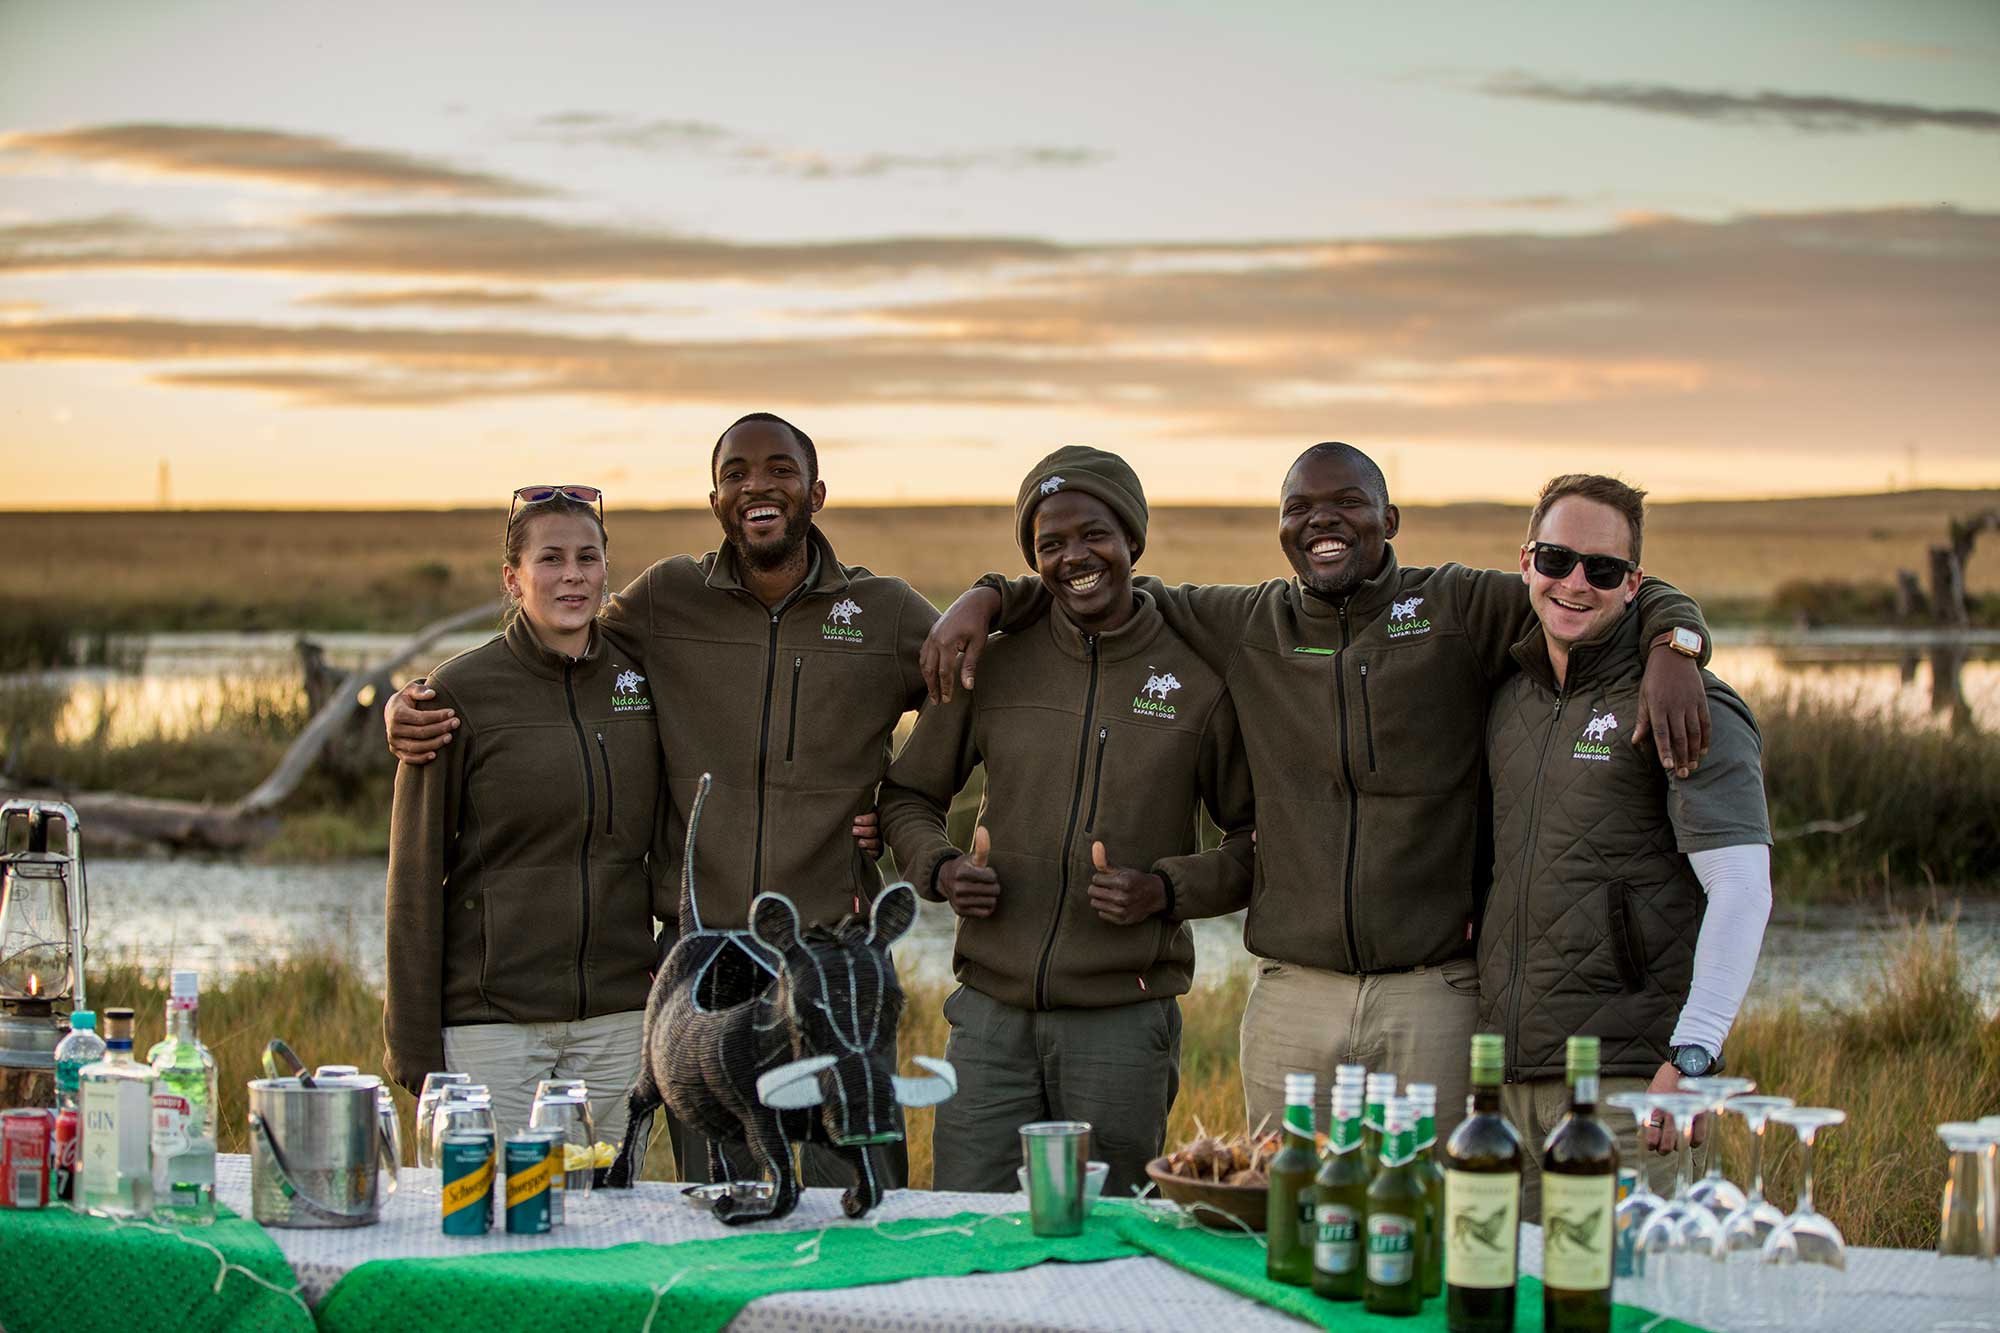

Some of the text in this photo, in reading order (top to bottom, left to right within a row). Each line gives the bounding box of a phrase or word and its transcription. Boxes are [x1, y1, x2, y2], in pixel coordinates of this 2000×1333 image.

[822, 623, 864, 637] Ndaka
[1387, 619, 1431, 633] Ndaka
[611, 694, 649, 706] Ndaka
[1132, 696, 1176, 714] Ndaka
[1133, 708, 1175, 720] SAFARI LODGE
[1573, 741, 1612, 754] Ndaka
[87, 1110, 115, 1131] GIN
[1370, 1232, 1409, 1252] LITE
